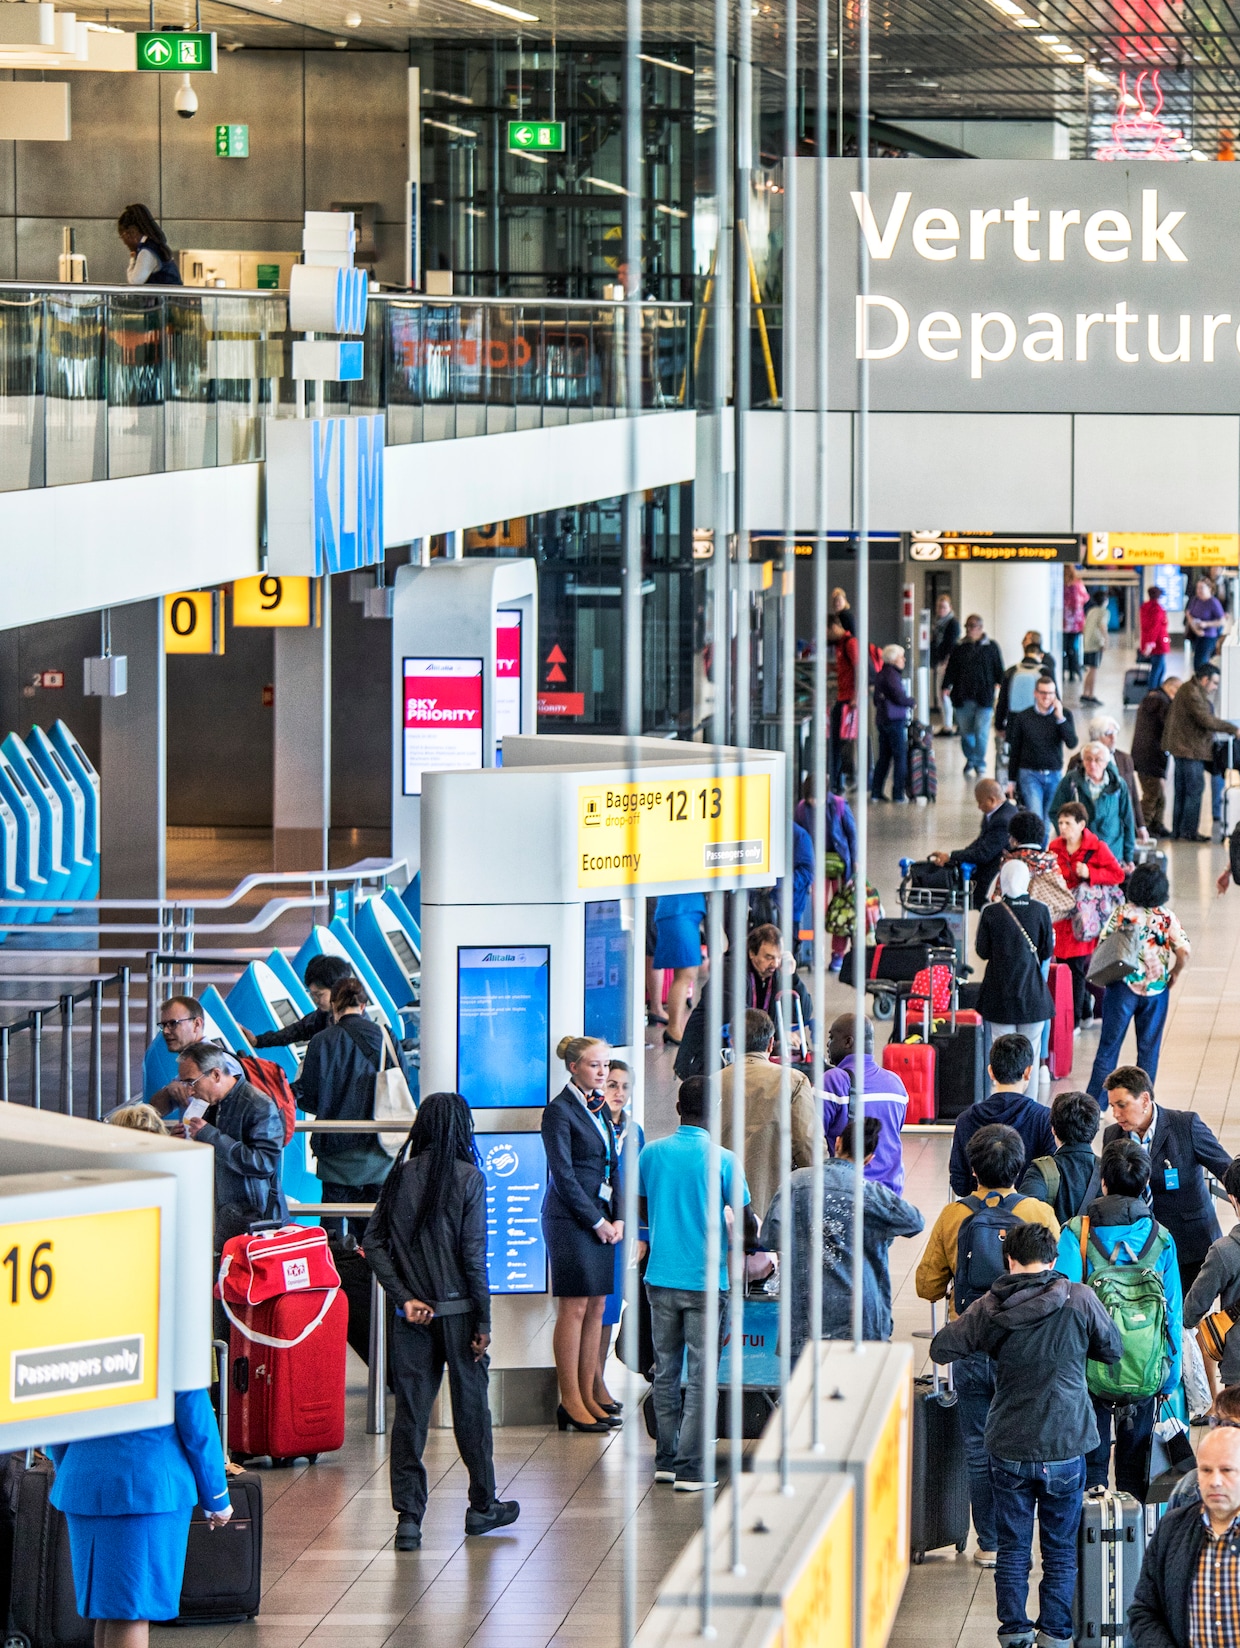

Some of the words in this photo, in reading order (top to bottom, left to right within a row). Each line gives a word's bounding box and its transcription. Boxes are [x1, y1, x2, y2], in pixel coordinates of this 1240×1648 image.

[850, 188, 1188, 263] Vertrek
[311, 414, 384, 575] KLM
[972, 545, 1017, 559] Baggage
[1018, 545, 1058, 559] storage
[1128, 548, 1165, 559] Parking
[1201, 546, 1220, 555] Exit
[259, 574, 283, 611] 9
[32, 673, 41, 686] 2
[407, 698, 437, 710] SKY
[407, 709, 476, 721] PRIORITY
[606, 791, 662, 811] Baggage
[666, 790, 688, 821] 12
[698, 787, 723, 820] 13
[605, 812, 641, 828] drop-off
[582, 851, 641, 871] Economy
[706, 849, 744, 862] Passengers
[745, 846, 761, 859] only
[481, 952, 516, 962] Alitalia
[2, 1241, 53, 1304] 16
[742, 1334, 765, 1346] TUI
[17, 1355, 102, 1387] Passengers
[103, 1348, 138, 1374] only
